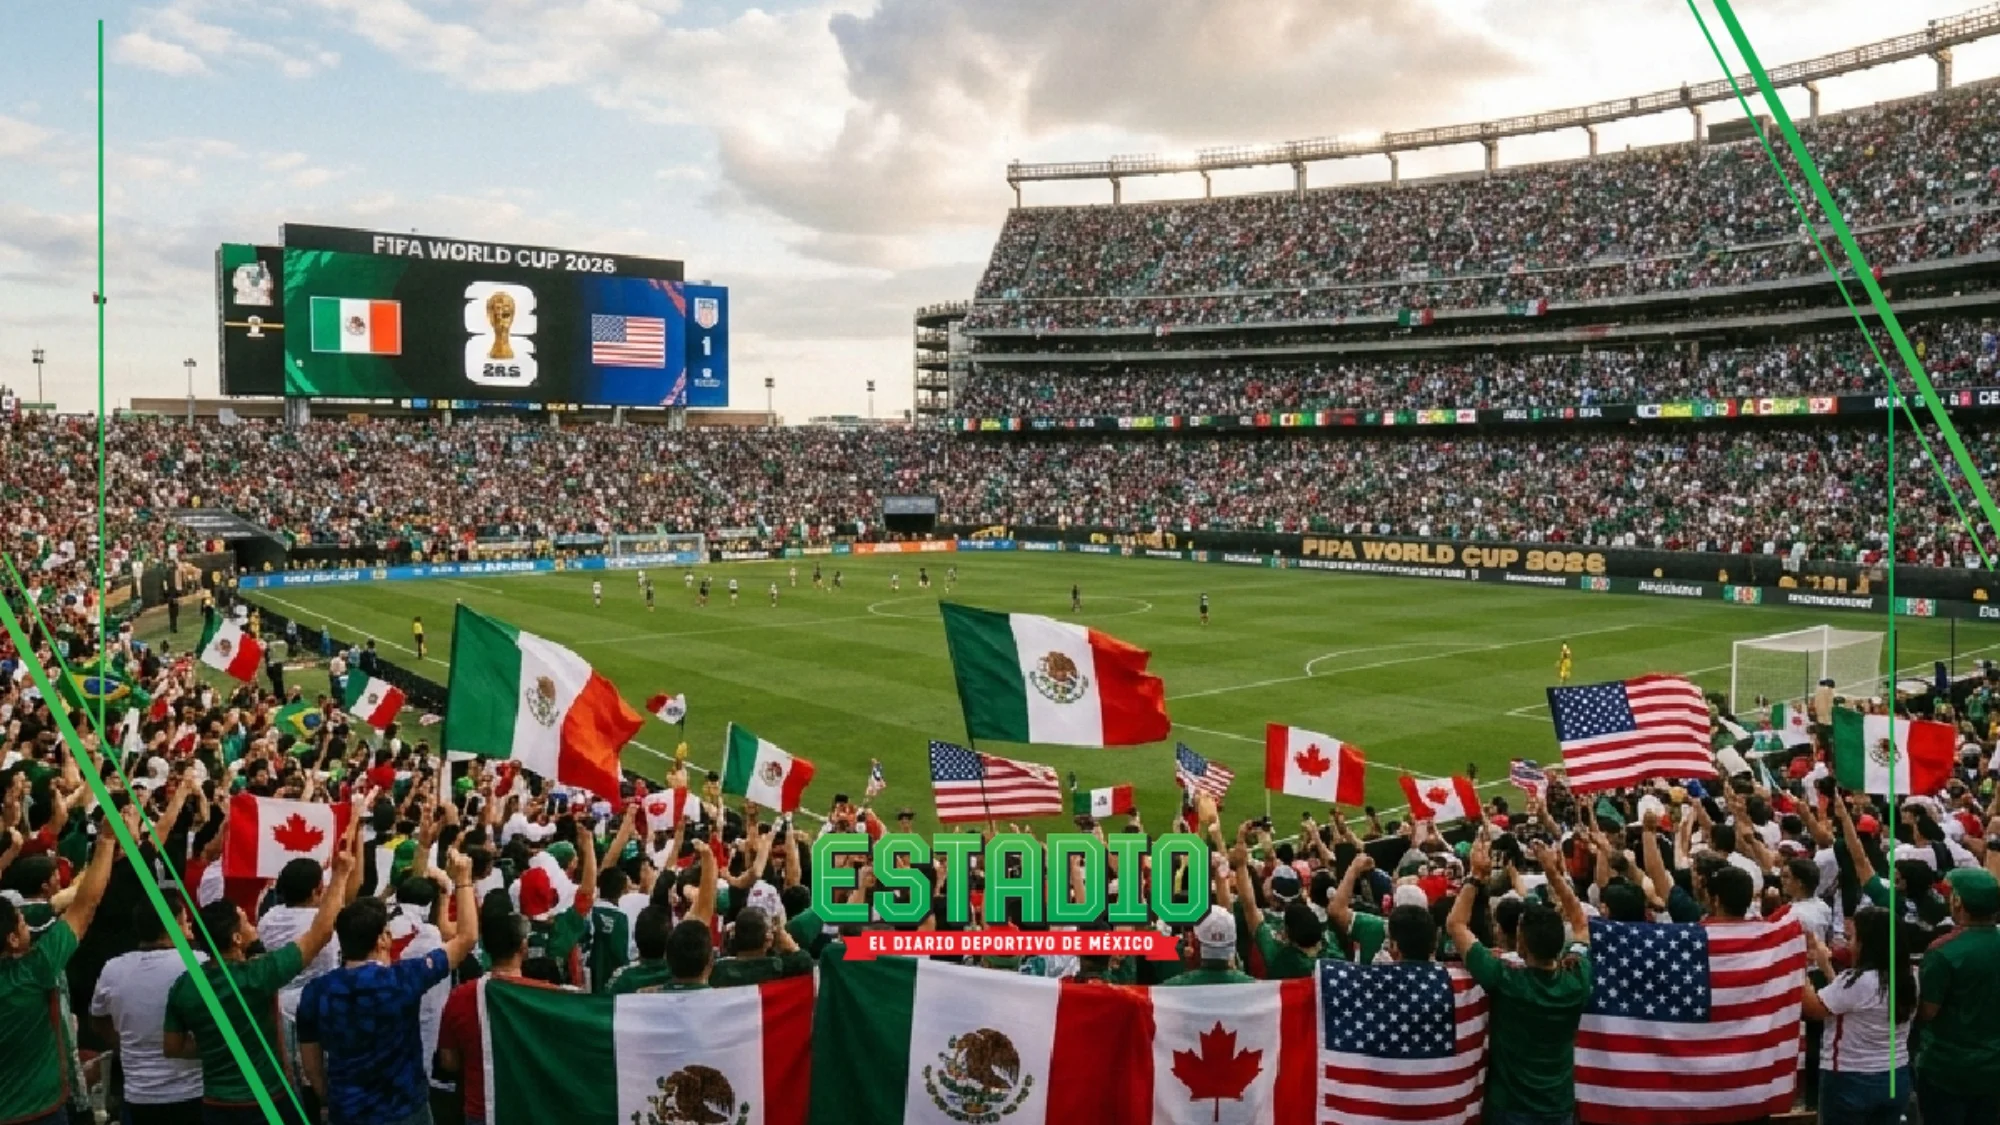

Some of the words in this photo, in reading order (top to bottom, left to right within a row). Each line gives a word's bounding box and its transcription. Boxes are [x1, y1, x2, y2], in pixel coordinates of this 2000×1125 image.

[372, 235, 424, 259] FIFA
[428, 241, 511, 264] WORLD
[515, 249, 560, 269] CUP
[564, 253, 617, 274] 2026
[702, 336, 711, 356] 1
[1362, 541, 1456, 564] WORLD
[1461, 546, 1519, 569] CUP
